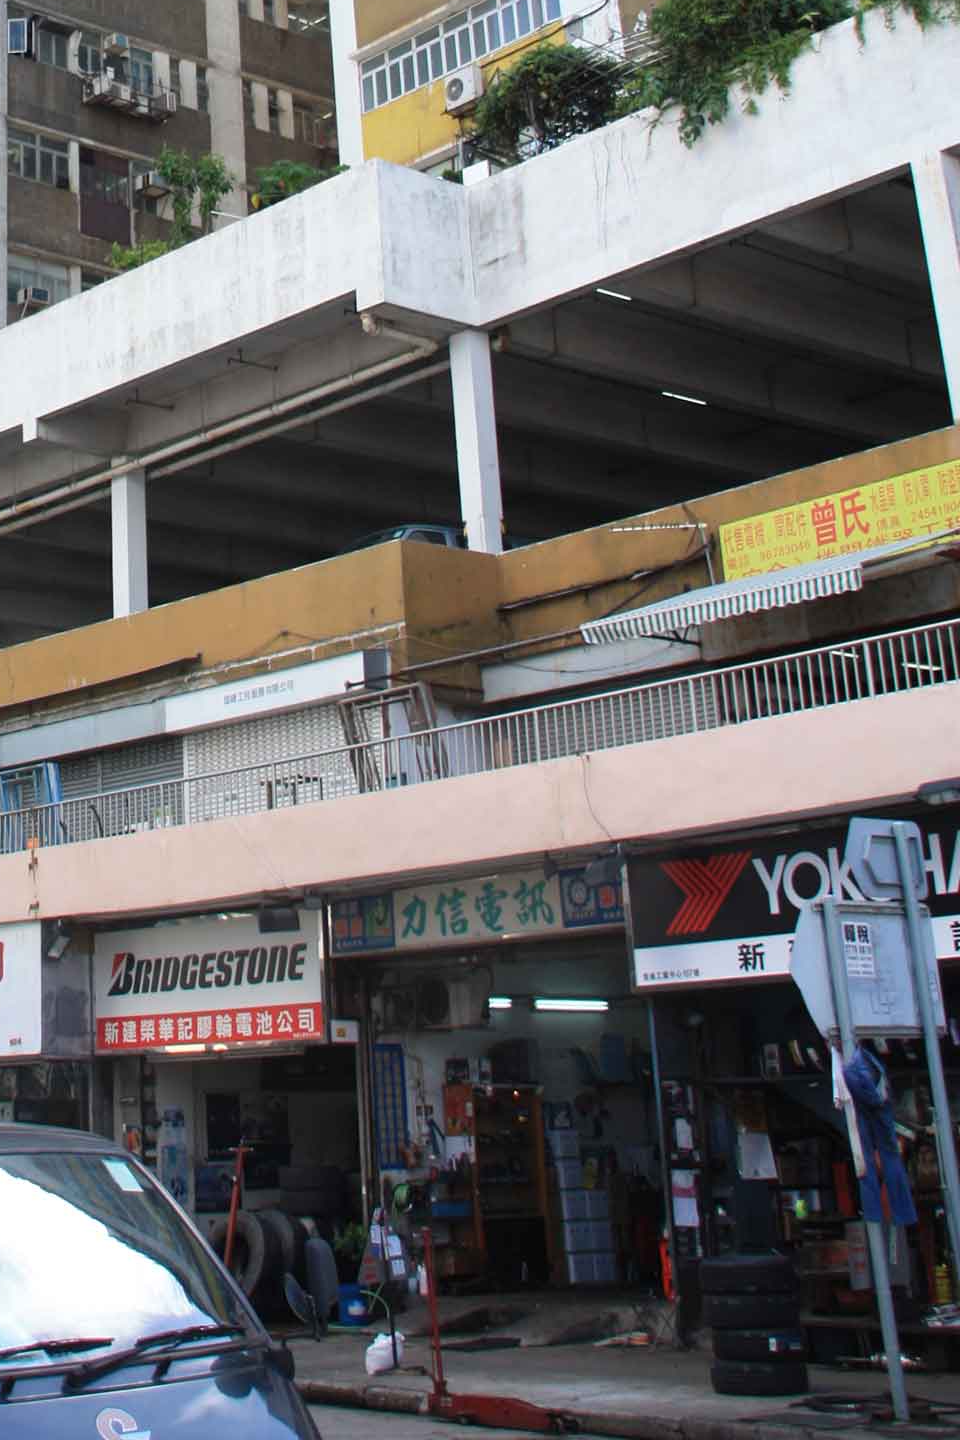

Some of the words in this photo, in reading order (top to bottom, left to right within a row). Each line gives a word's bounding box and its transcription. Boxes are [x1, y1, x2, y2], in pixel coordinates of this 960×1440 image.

[811, 490, 870, 547] 曾氏
[400, 878, 556, 939] 力信電訊
[107, 942, 307, 997] BRIDGESTONE
[103, 1007, 316, 1045] 新建榮華記膠輪電池公司
